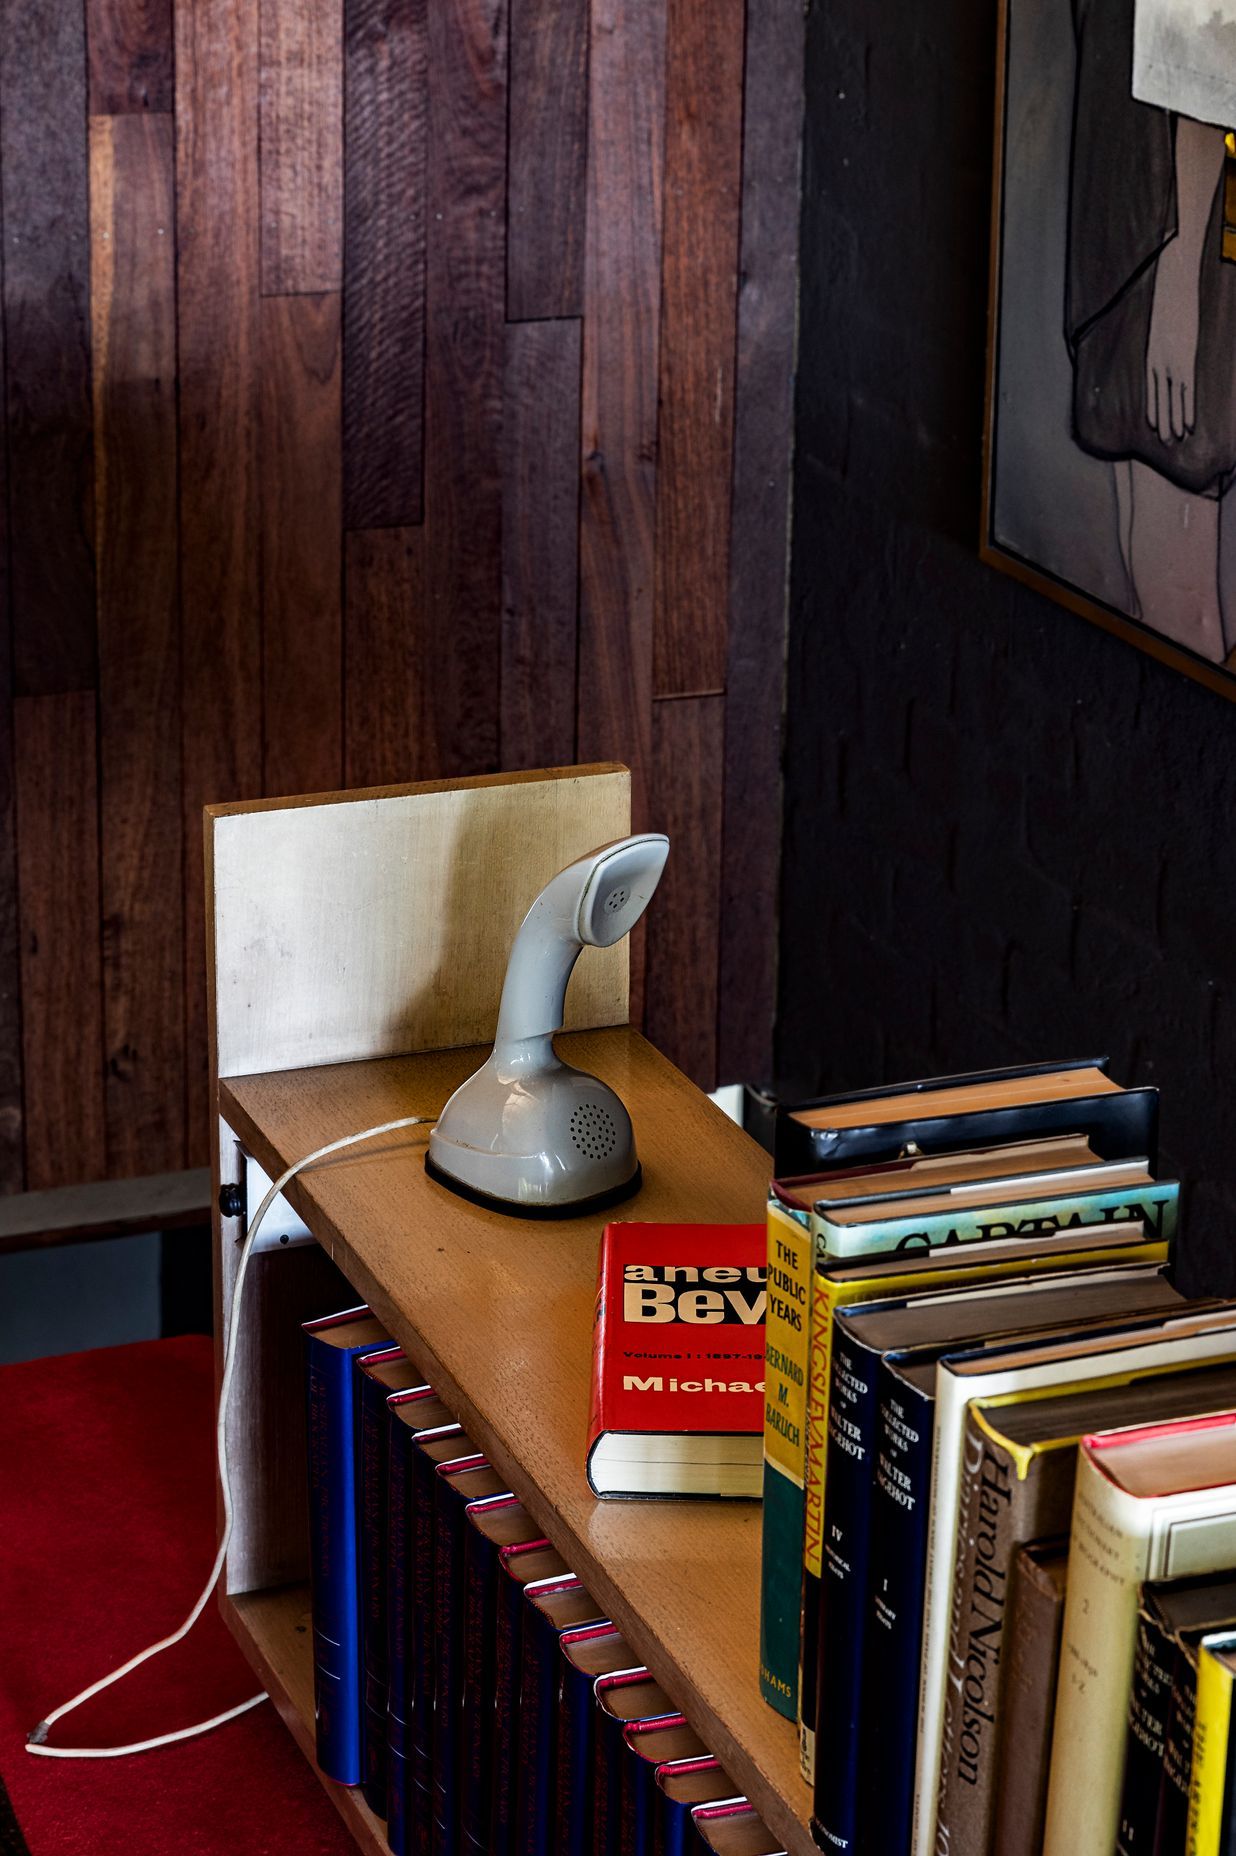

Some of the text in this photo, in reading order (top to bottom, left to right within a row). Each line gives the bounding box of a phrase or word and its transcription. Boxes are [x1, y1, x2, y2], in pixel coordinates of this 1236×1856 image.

[776, 1239, 798, 1270] THE
[767, 1262, 806, 1305] PUBLIC
[770, 1293, 802, 1332] YEARS
[623, 1351, 682, 1359] Volume
[766, 1342, 804, 1387] BERNARD
[778, 1382, 789, 1408] M.
[766, 1402, 800, 1447] BARUCH
[806, 1433, 824, 1563] MARTIN
[831, 1525, 843, 1542] IV
[957, 1451, 1012, 1786] Harold Nicolson
